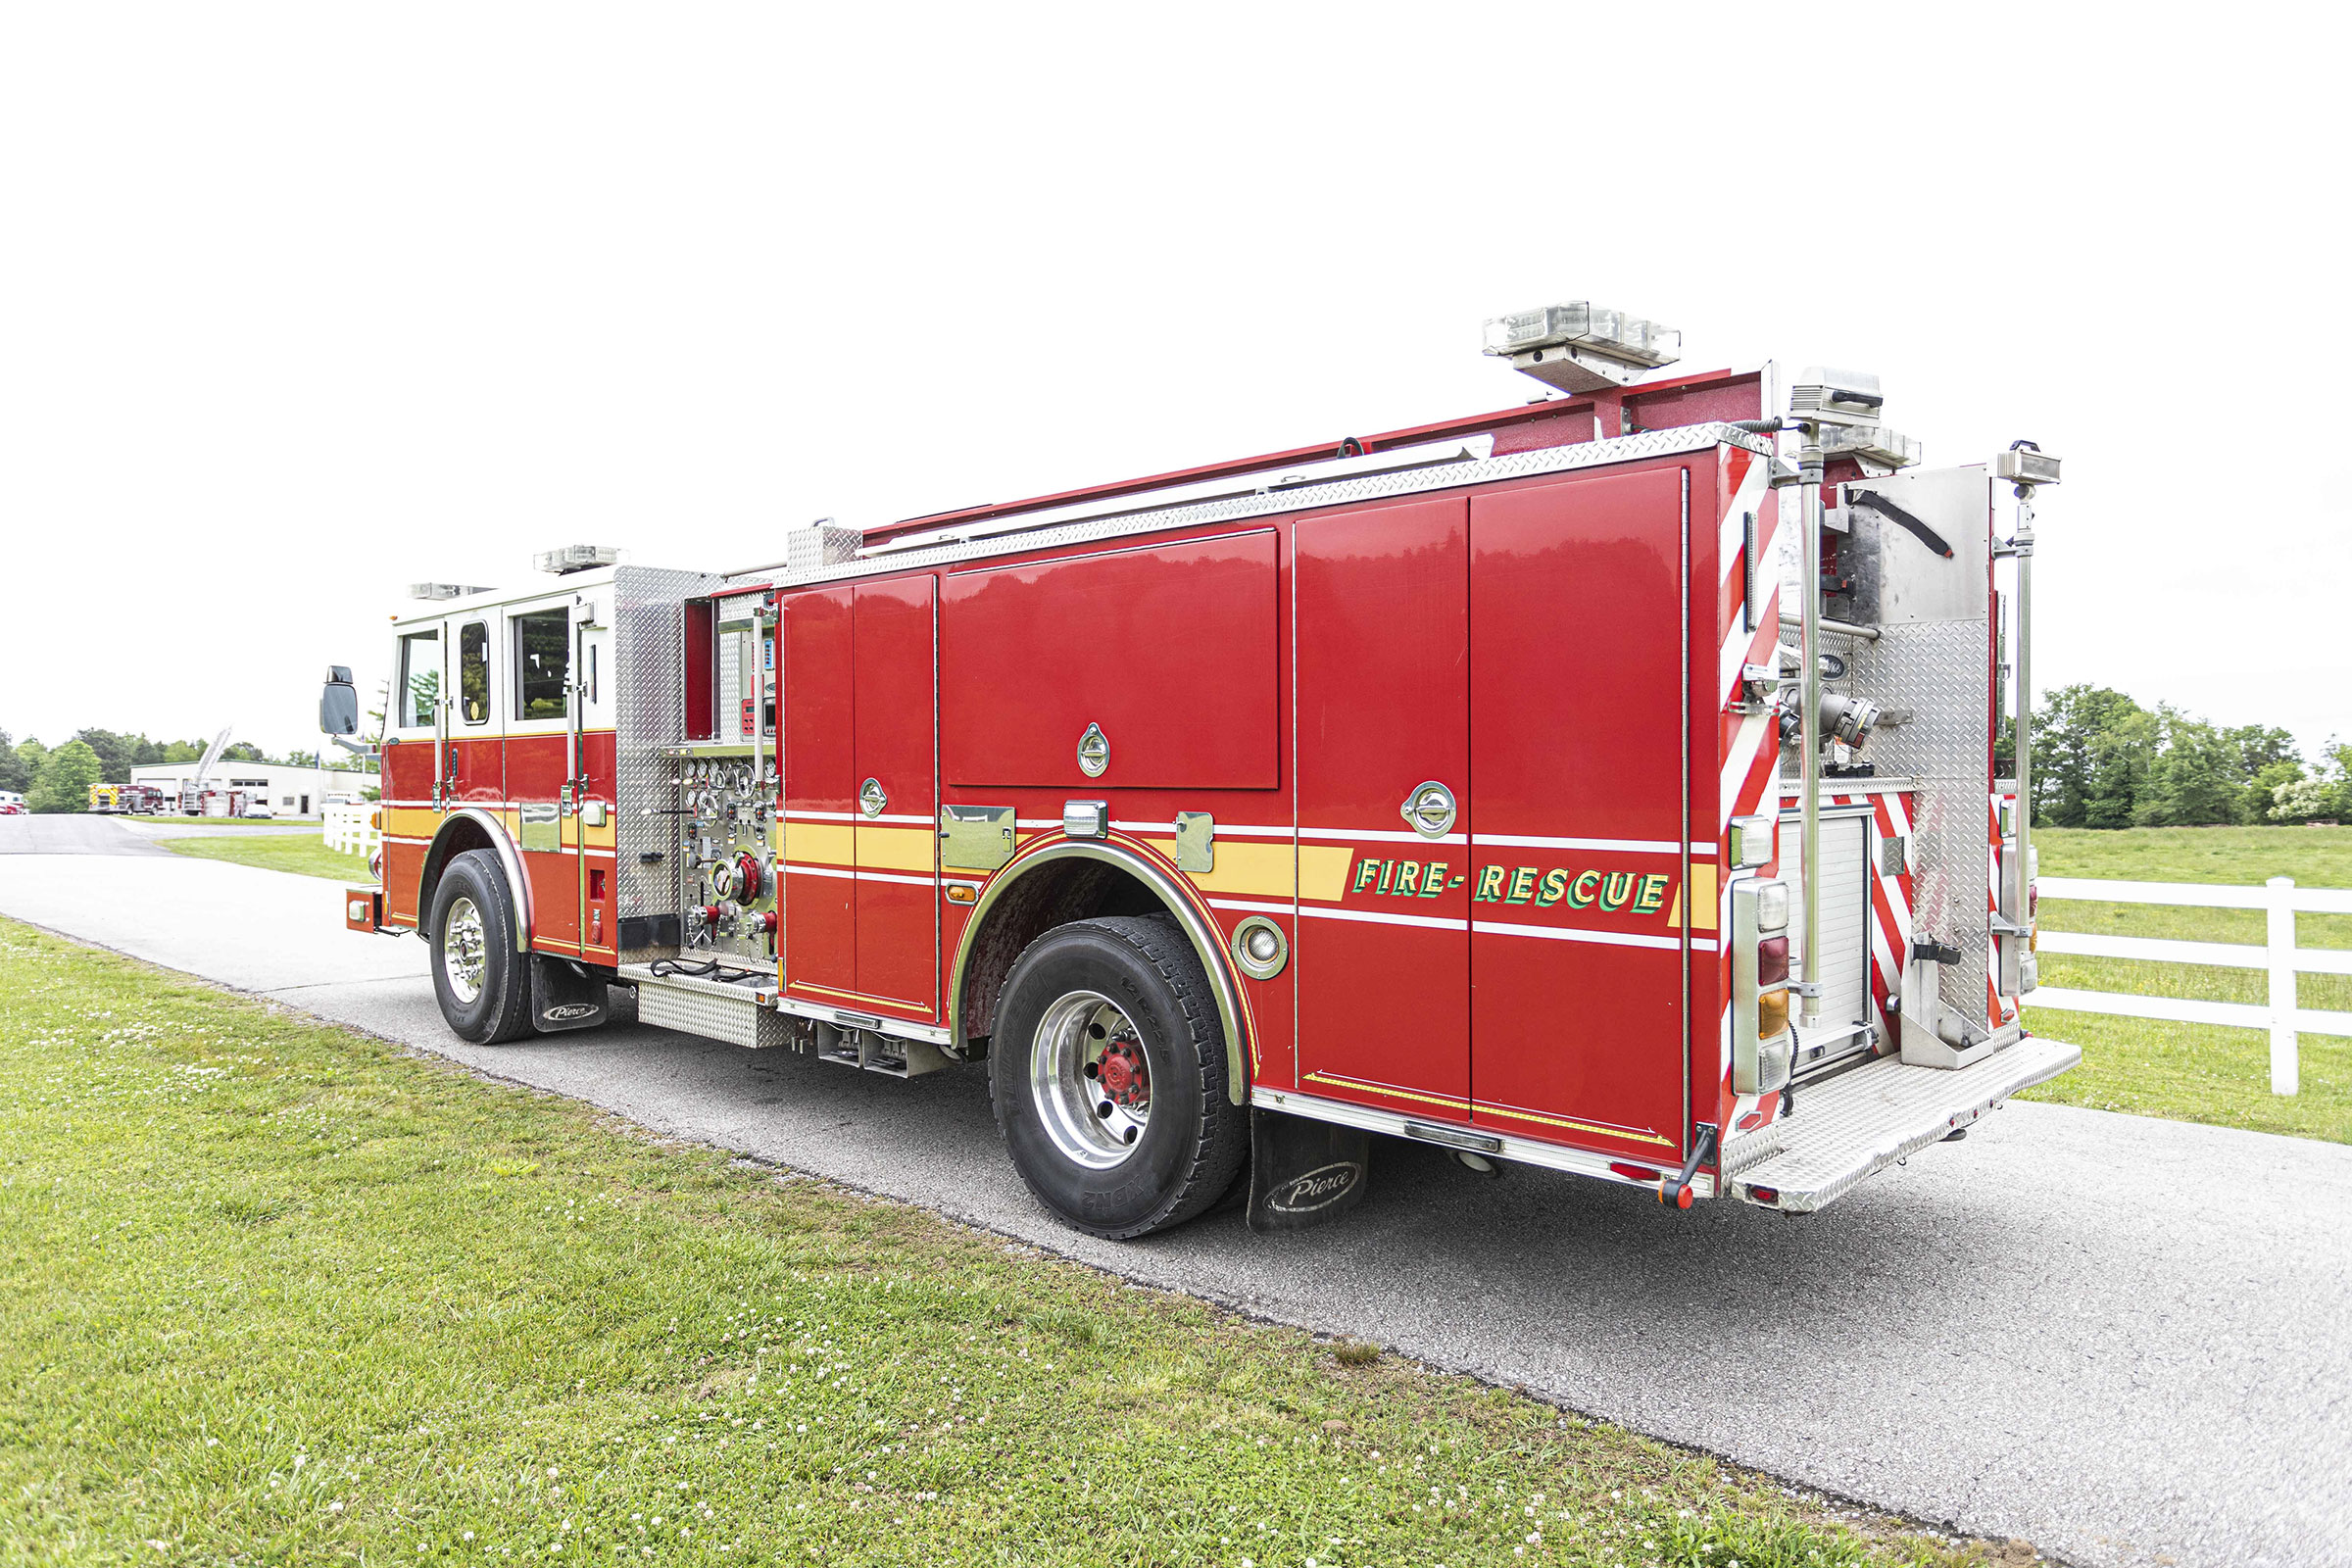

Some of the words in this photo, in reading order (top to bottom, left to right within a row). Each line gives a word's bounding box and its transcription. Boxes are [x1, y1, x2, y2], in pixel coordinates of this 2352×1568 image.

[1351, 858, 1465, 899] FIRE-
[1473, 863, 1670, 914] RESCUE
[555, 1006, 587, 1019] Pierce
[1288, 1170, 1349, 1205] Pierce
